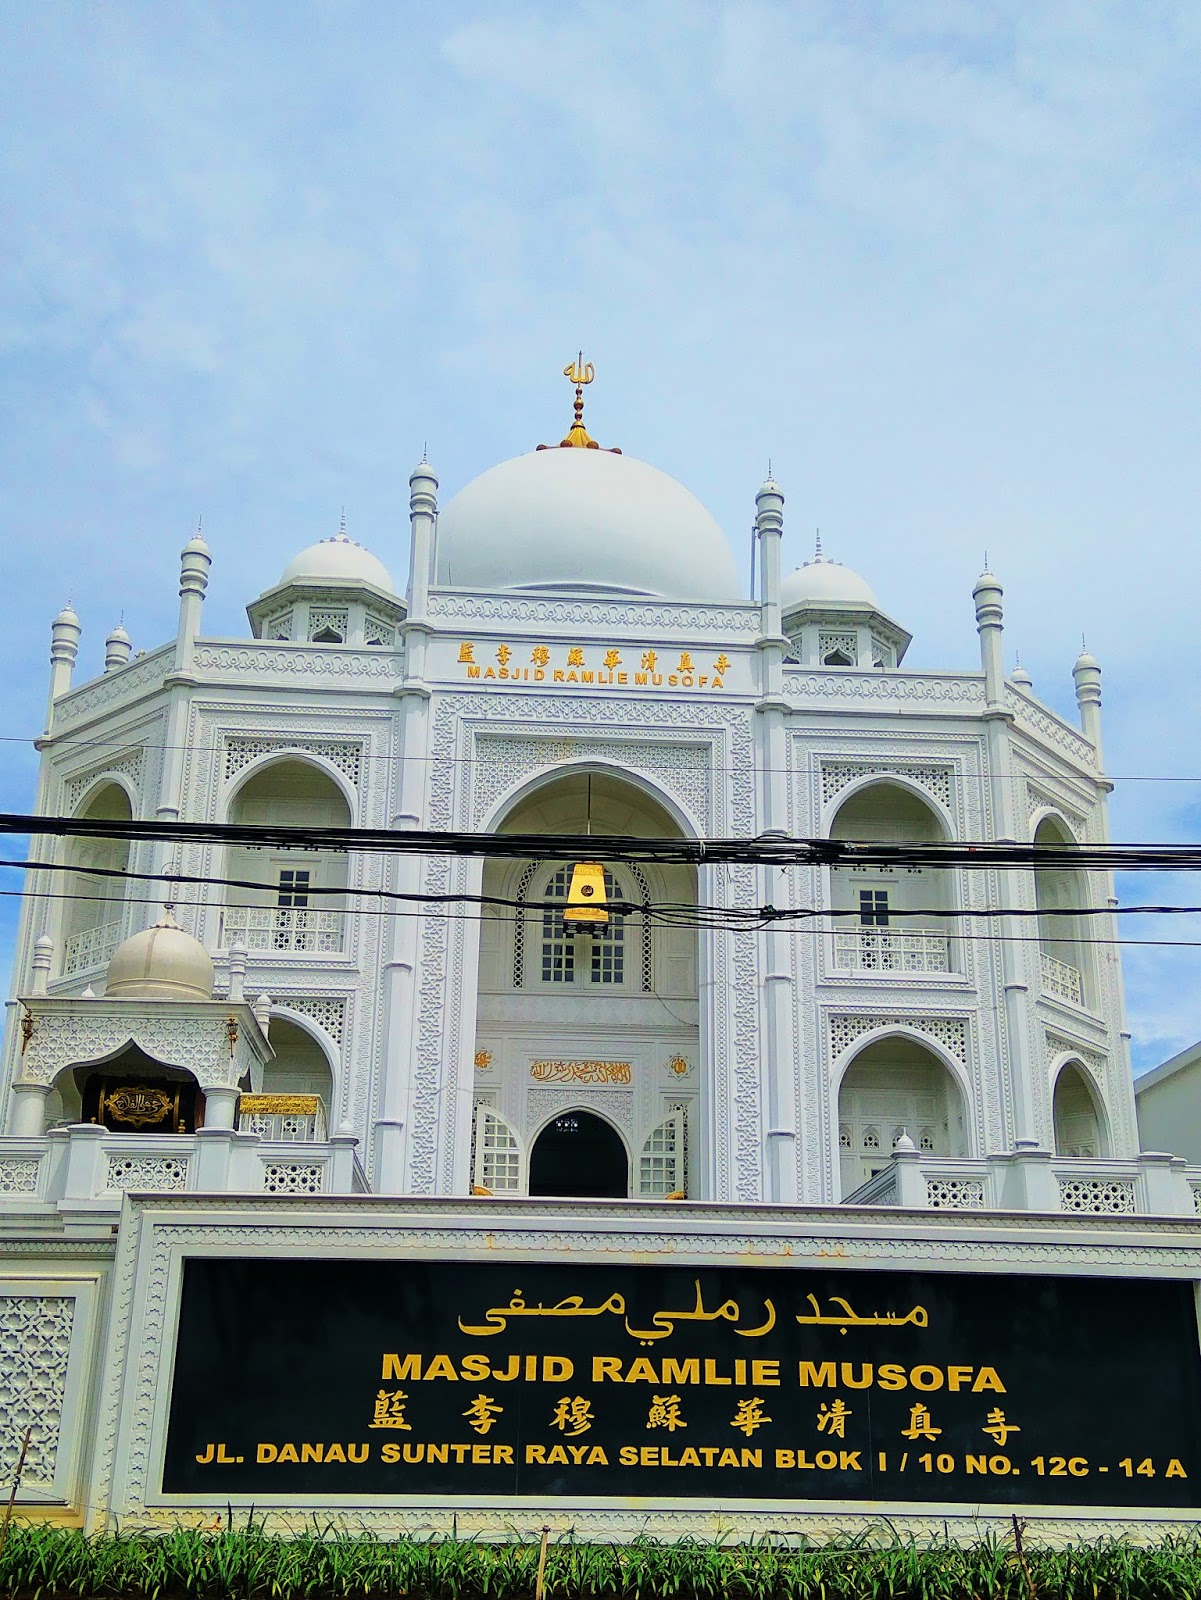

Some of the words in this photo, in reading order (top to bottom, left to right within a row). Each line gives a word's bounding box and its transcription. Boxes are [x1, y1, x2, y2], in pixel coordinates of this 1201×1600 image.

[467, 666, 545, 681] MASJID
[553, 669, 628, 685] RAMLIE
[634, 672, 724, 688] MUSOFA
[625, 1279, 777, 1347] رملي
[795, 1293, 929, 1335] مسجد
[381, 1353, 575, 1383] MASJID
[591, 1356, 781, 1387] RAMLIE
[798, 1360, 1007, 1393] MUSOFA
[368, 1389, 1021, 1447] 藍李穆蘇華清真寺
[195, 1443, 245, 1464] JL.
[256, 1443, 370, 1464] DANAU
[381, 1443, 514, 1465] SUNTER
[525, 1444, 609, 1466] RAYA
[618, 1445, 763, 1468] SELATAN
[775, 1448, 862, 1471] BLOK
[965, 1454, 1021, 1475] NO.
[1030, 1455, 1090, 1477] 12C
[1118, 1457, 1156, 1478] 14
[1164, 1458, 1189, 1479] A
